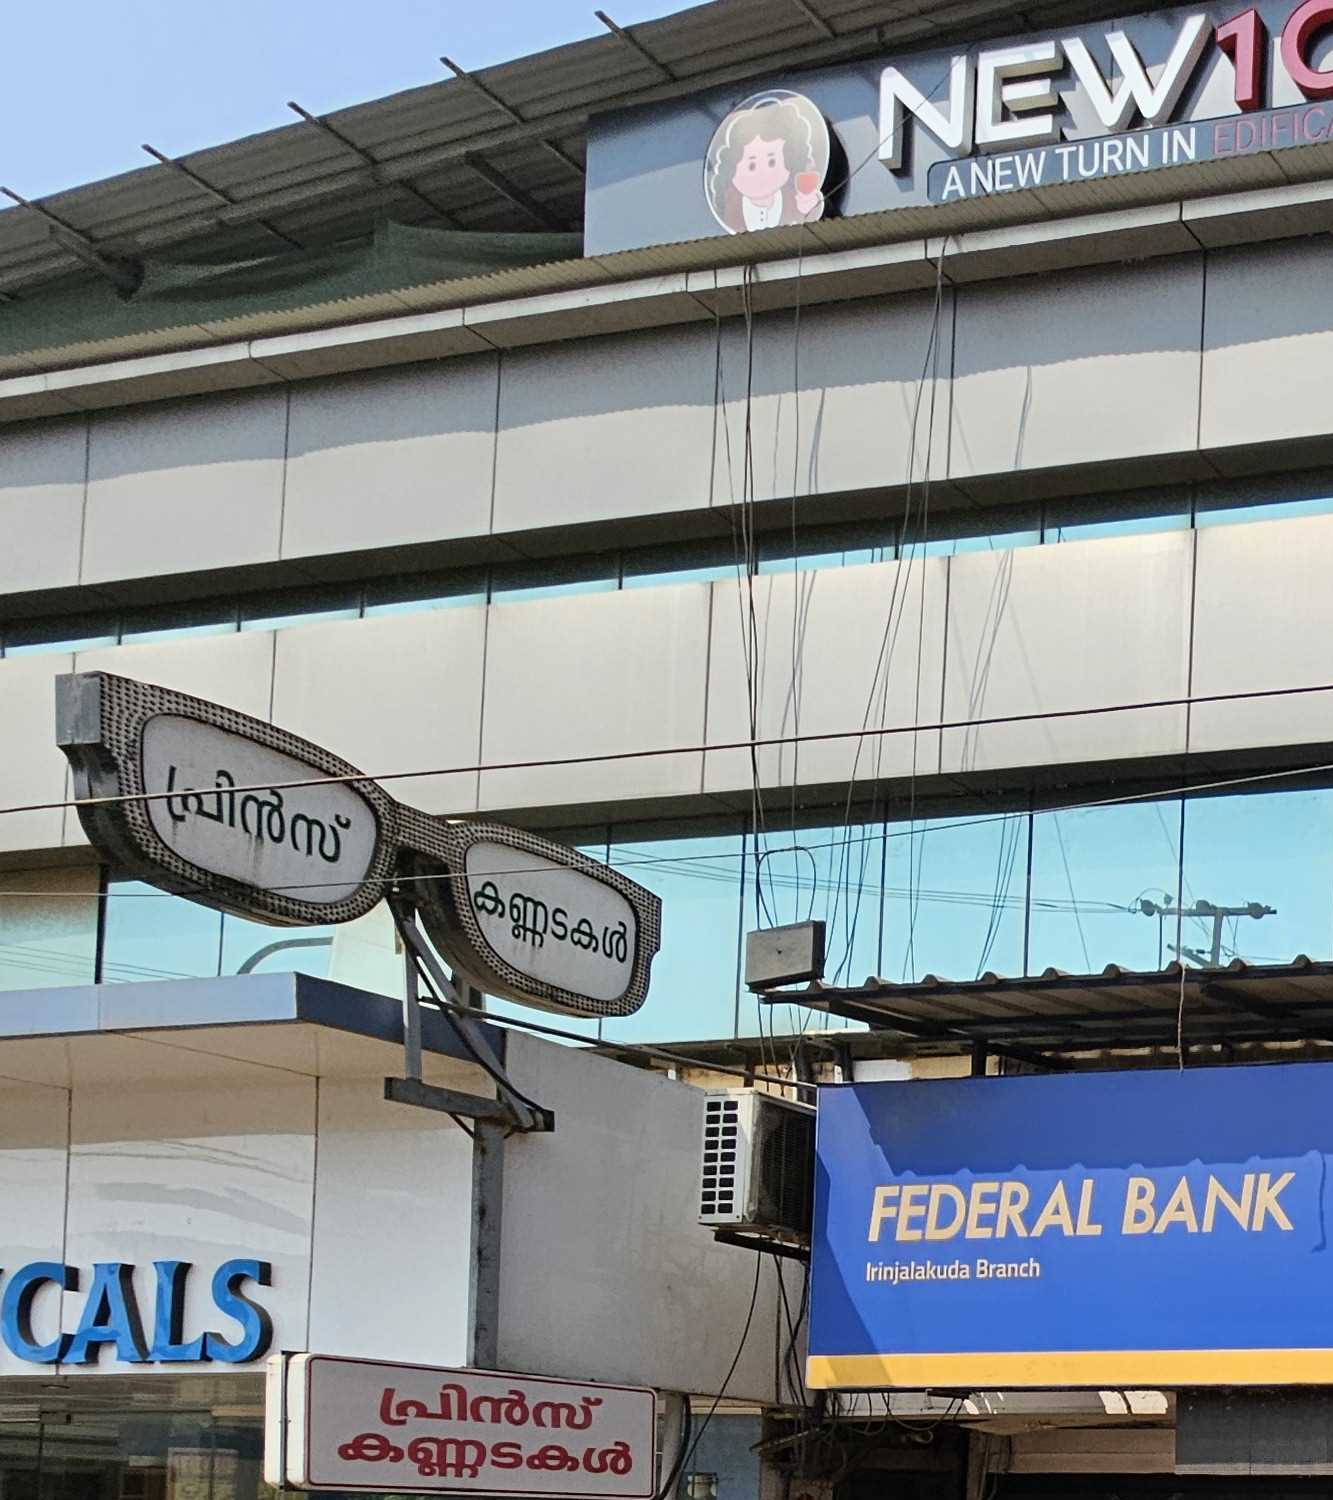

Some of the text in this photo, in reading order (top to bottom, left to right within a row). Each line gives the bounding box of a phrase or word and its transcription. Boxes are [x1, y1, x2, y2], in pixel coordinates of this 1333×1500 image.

[1055, 134, 1150, 180] TURN
[1162, 127, 1196, 164] IN
[165, 764, 351, 863] പ്രിൻസ്
[473, 879, 628, 964] കണ്ണടകൾ
[866, 1171, 1297, 1243] FEDERAL BANK
[865, 1256, 1041, 1287] Irinjalakuda Branch
[378, 1382, 603, 1431] പ്രിൻസ്
[336, 1428, 634, 1479] കണ്ണടകൾ
